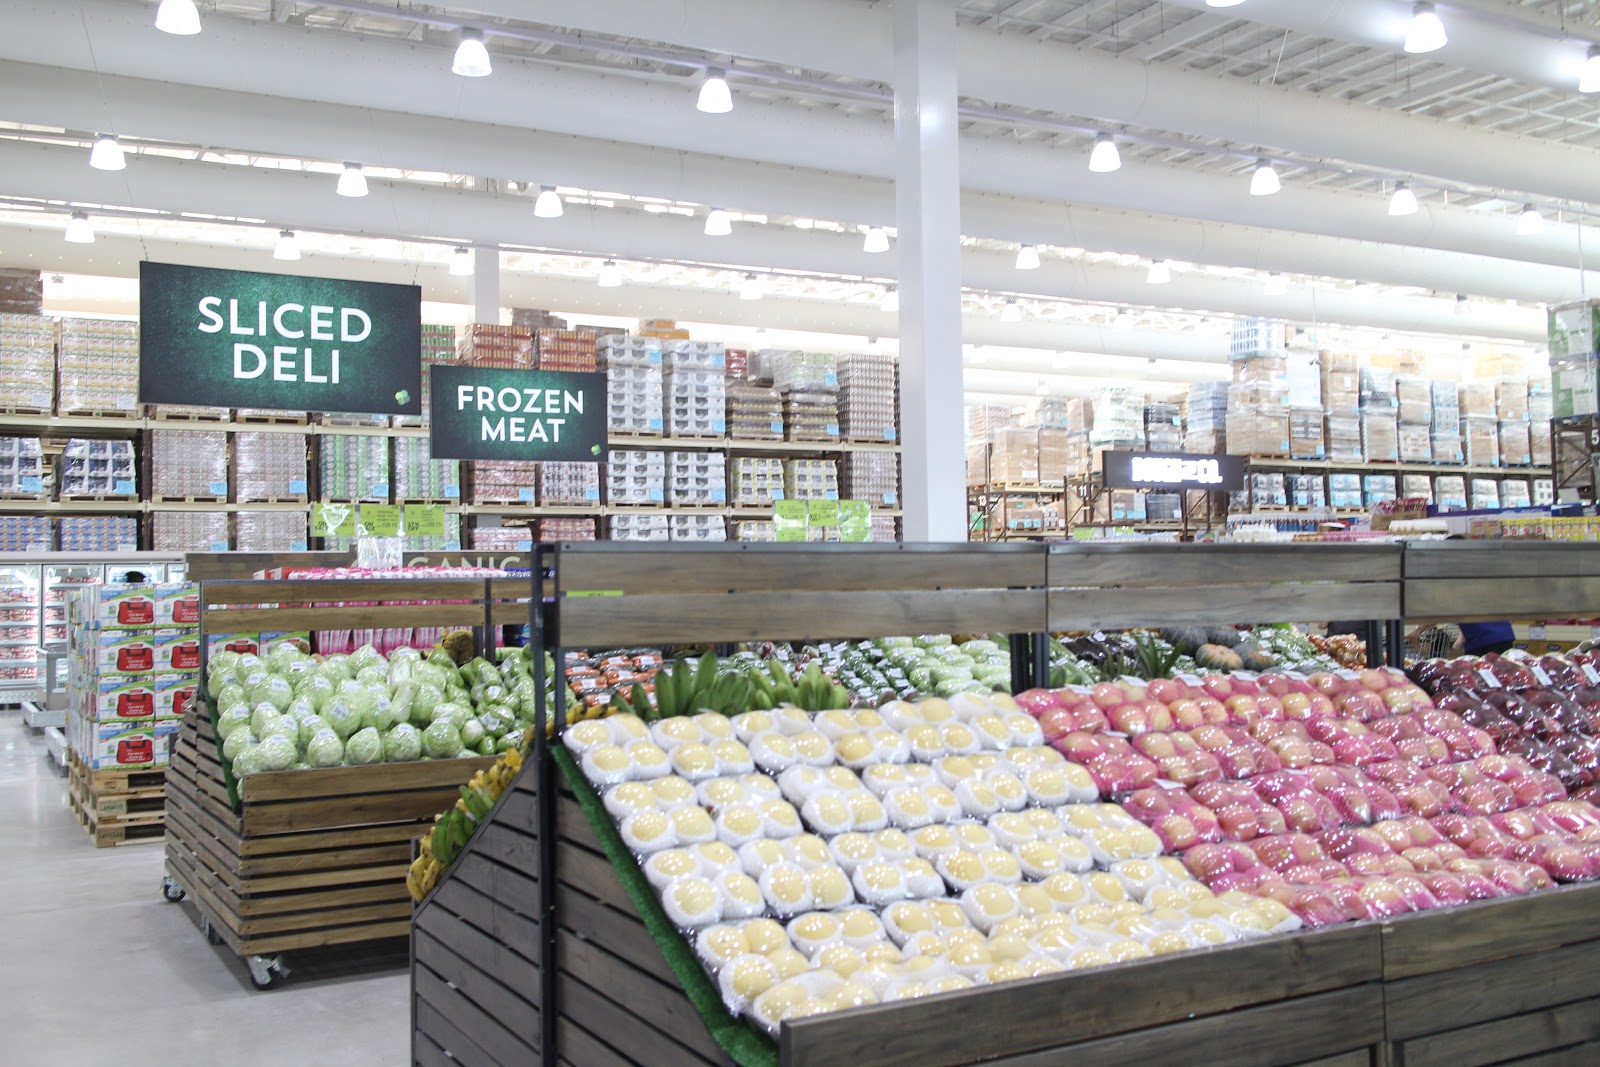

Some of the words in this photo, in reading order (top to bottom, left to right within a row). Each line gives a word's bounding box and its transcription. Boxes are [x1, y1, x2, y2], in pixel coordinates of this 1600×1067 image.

[198, 296, 372, 342] SLICED
[233, 343, 339, 384] DELI
[457, 385, 584, 415] FROZEN
[481, 416, 566, 443] MEAT
[1591, 429, 1600, 445] 5
[978, 495, 987, 506] 13
[1079, 485, 1087, 497] 11
